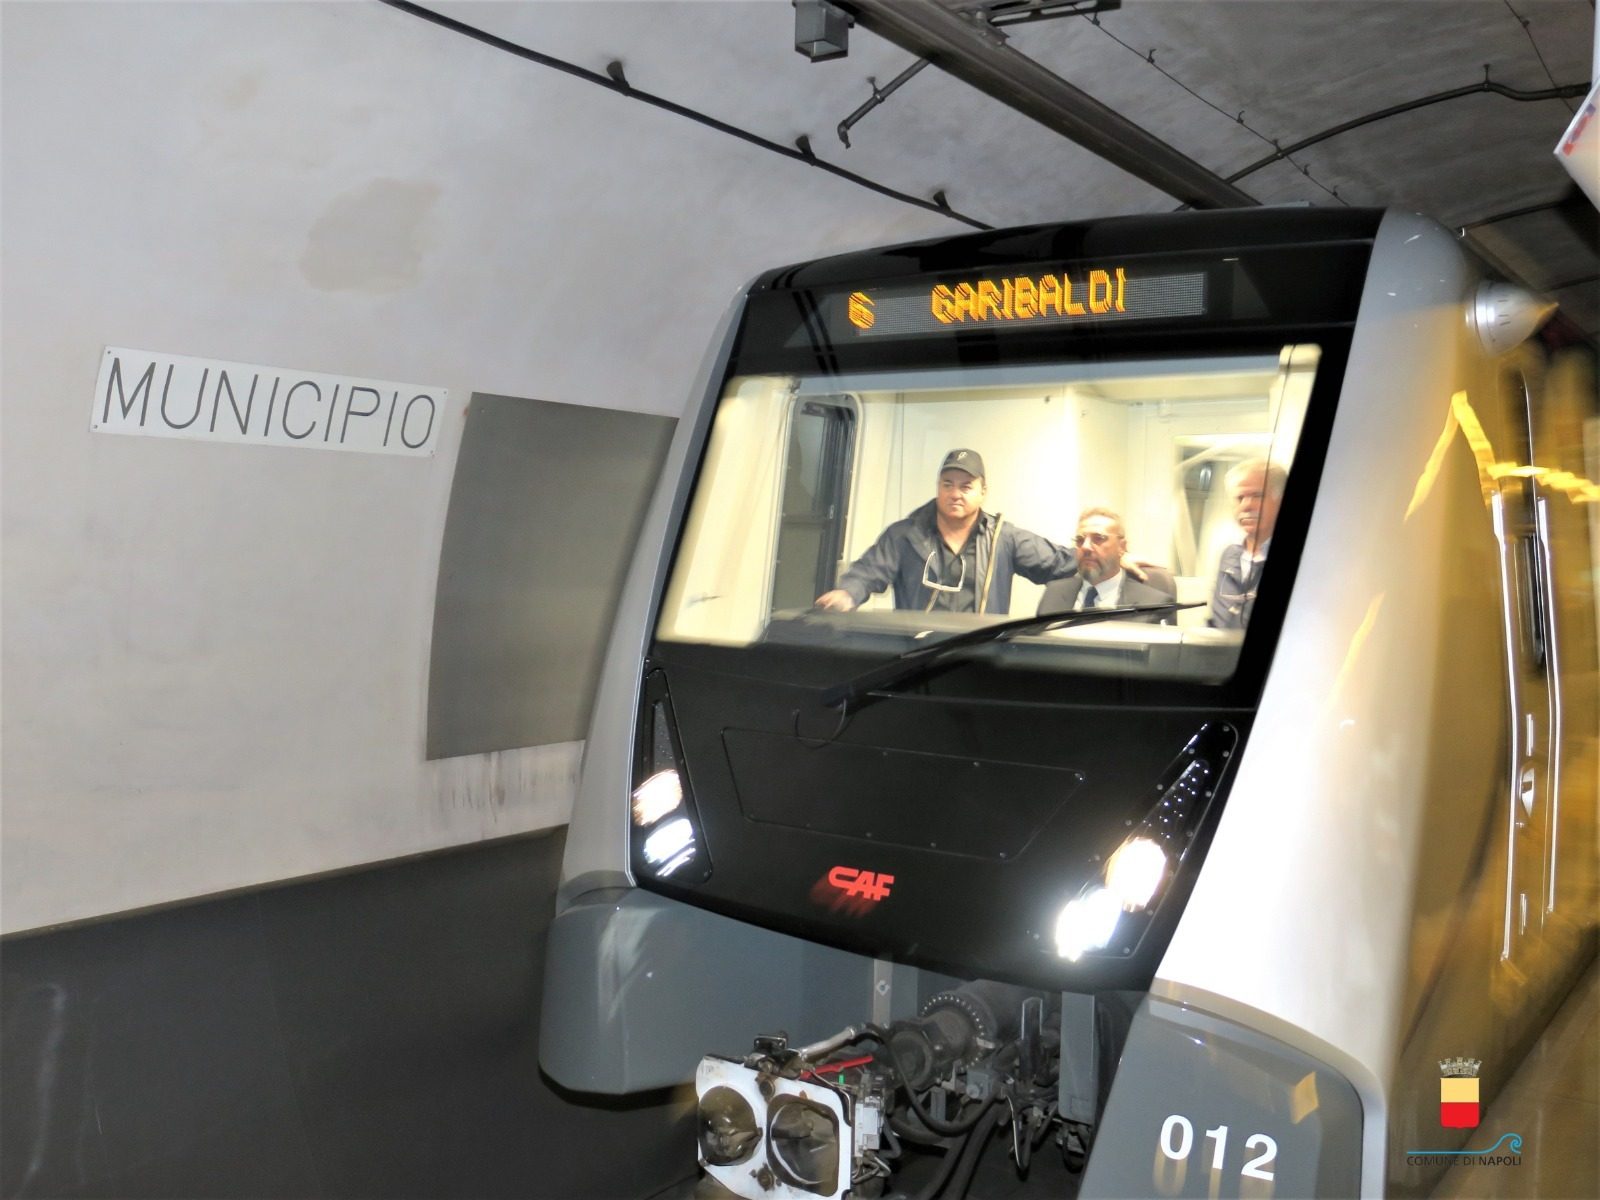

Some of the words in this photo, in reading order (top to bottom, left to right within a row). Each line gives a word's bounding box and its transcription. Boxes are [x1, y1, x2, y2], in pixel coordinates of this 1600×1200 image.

[848, 291, 875, 329] 6
[931, 267, 1127, 324] GARIBALDI
[102, 357, 436, 449] MUNICIPIO
[828, 865, 895, 901] CAF
[1159, 1114, 1278, 1181] 012
